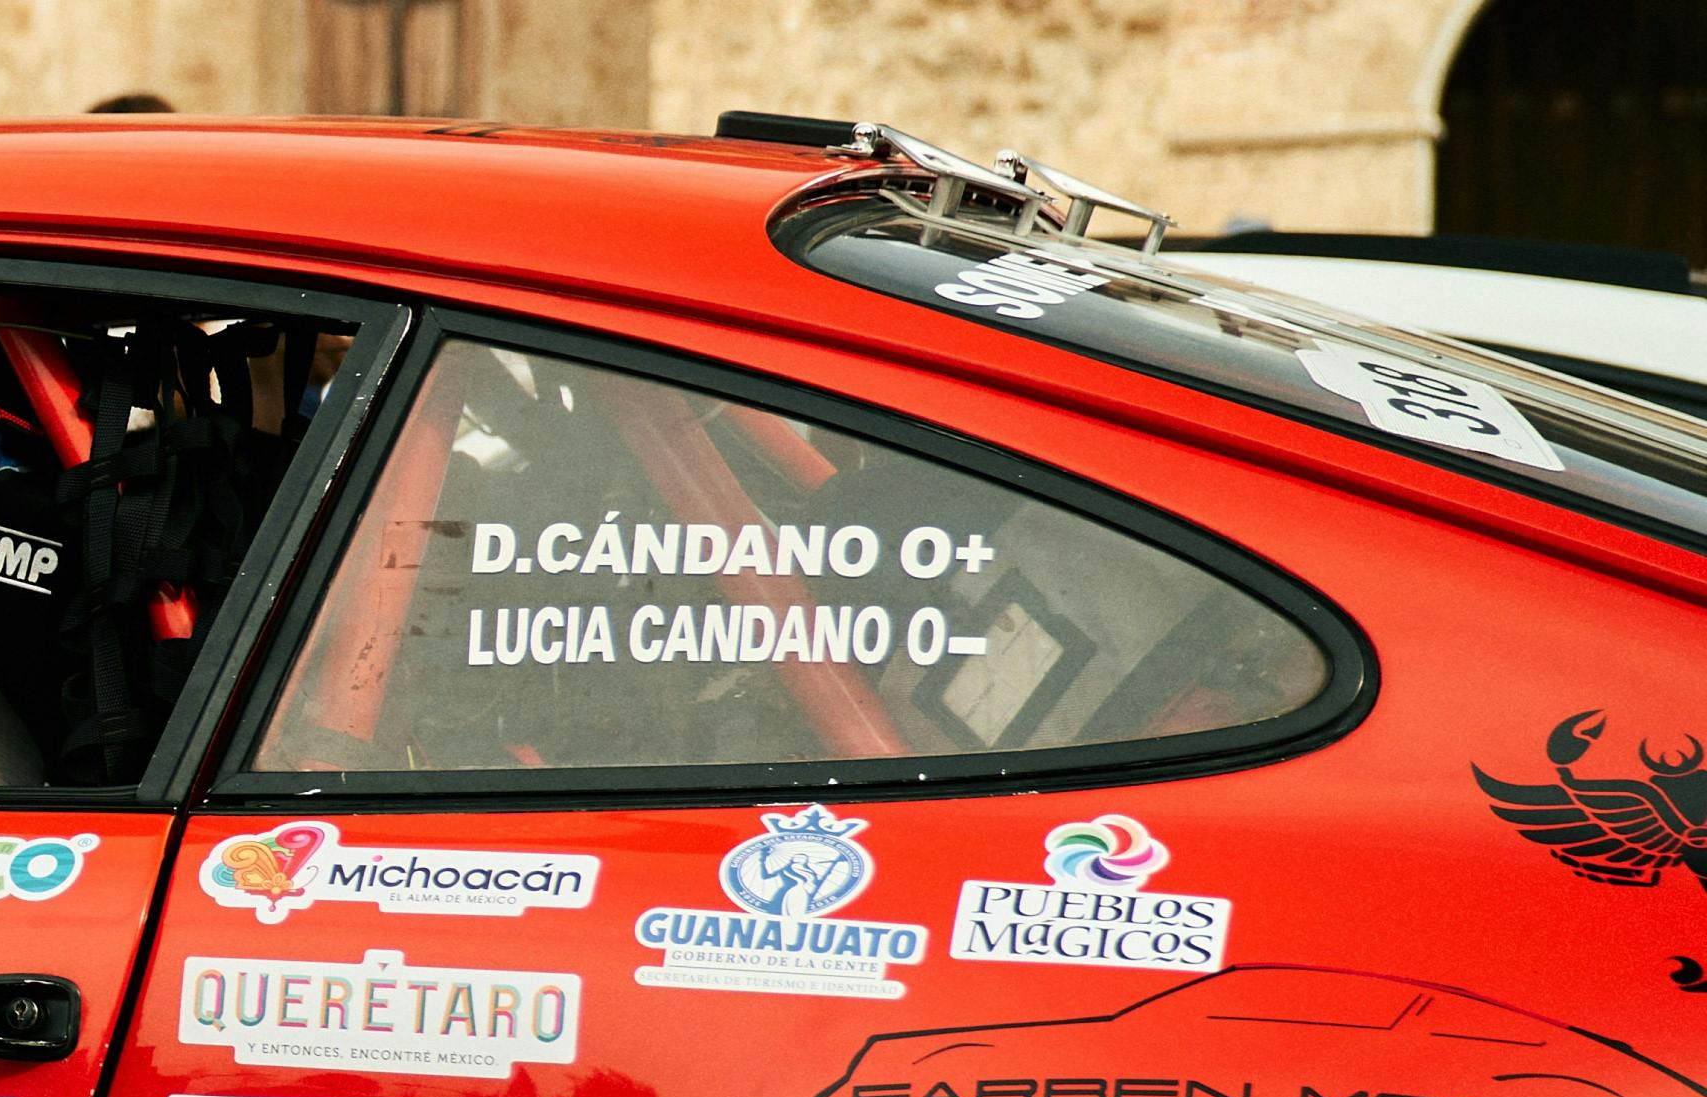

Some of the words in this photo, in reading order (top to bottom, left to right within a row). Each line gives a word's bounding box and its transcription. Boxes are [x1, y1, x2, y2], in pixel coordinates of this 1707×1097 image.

[1357, 361, 1500, 436] 318
[471, 511, 880, 579] D.CÁNDANO
[468, 606, 617, 666] LUCIA
[628, 604, 890, 667] CANDANO
[328, 855, 582, 896] Michoacán
[407, 893, 441, 902] ALMA
[640, 912, 918, 960] GUANAJUATO
[671, 949, 761, 966] GOBIERNO
[767, 955, 788, 968] DE
[794, 957, 816, 969] LA
[822, 959, 879, 973] GENTE
[247, 1042, 258, 1054] Y
